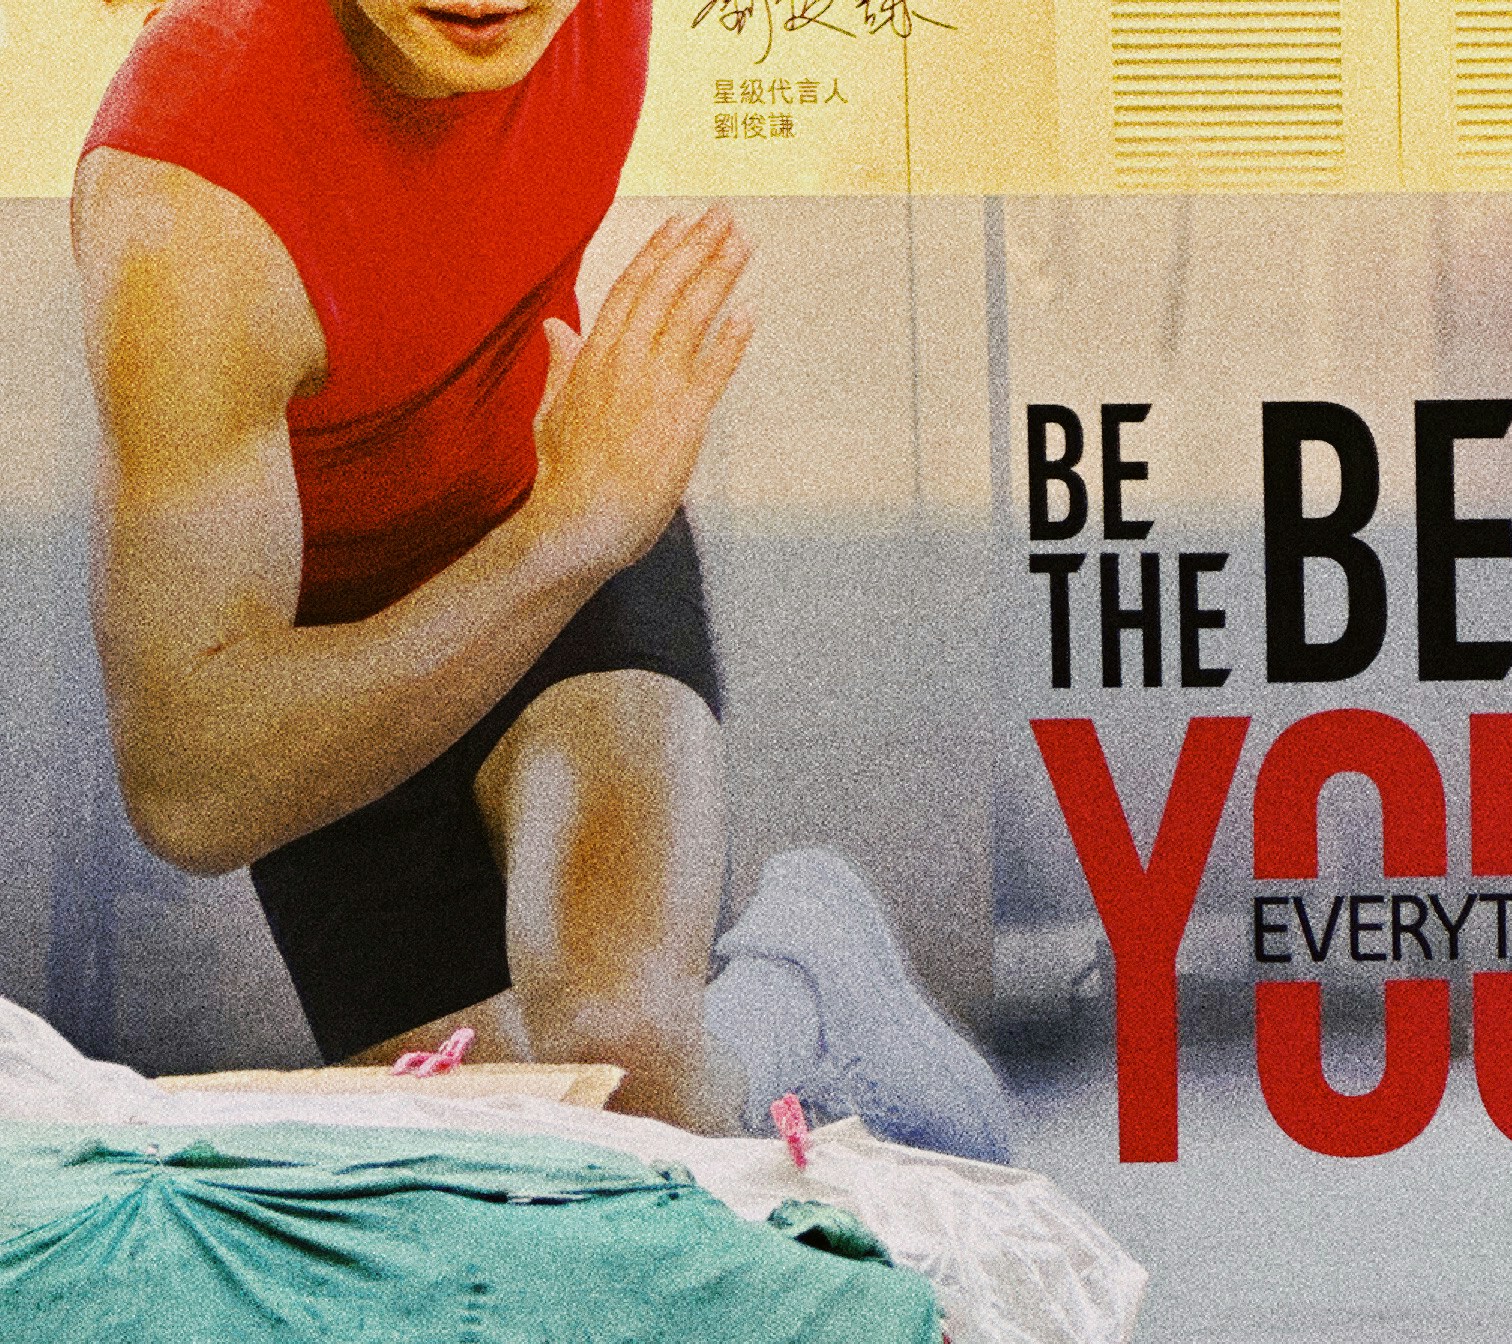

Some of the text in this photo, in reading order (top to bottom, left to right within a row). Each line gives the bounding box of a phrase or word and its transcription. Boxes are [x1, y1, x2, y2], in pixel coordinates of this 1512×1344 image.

[713, 78, 849, 105] 星級代言人
[713, 112, 796, 140] 劉俊謙
[1027, 403, 1153, 541] BE
[1029, 552, 1231, 689] THE
